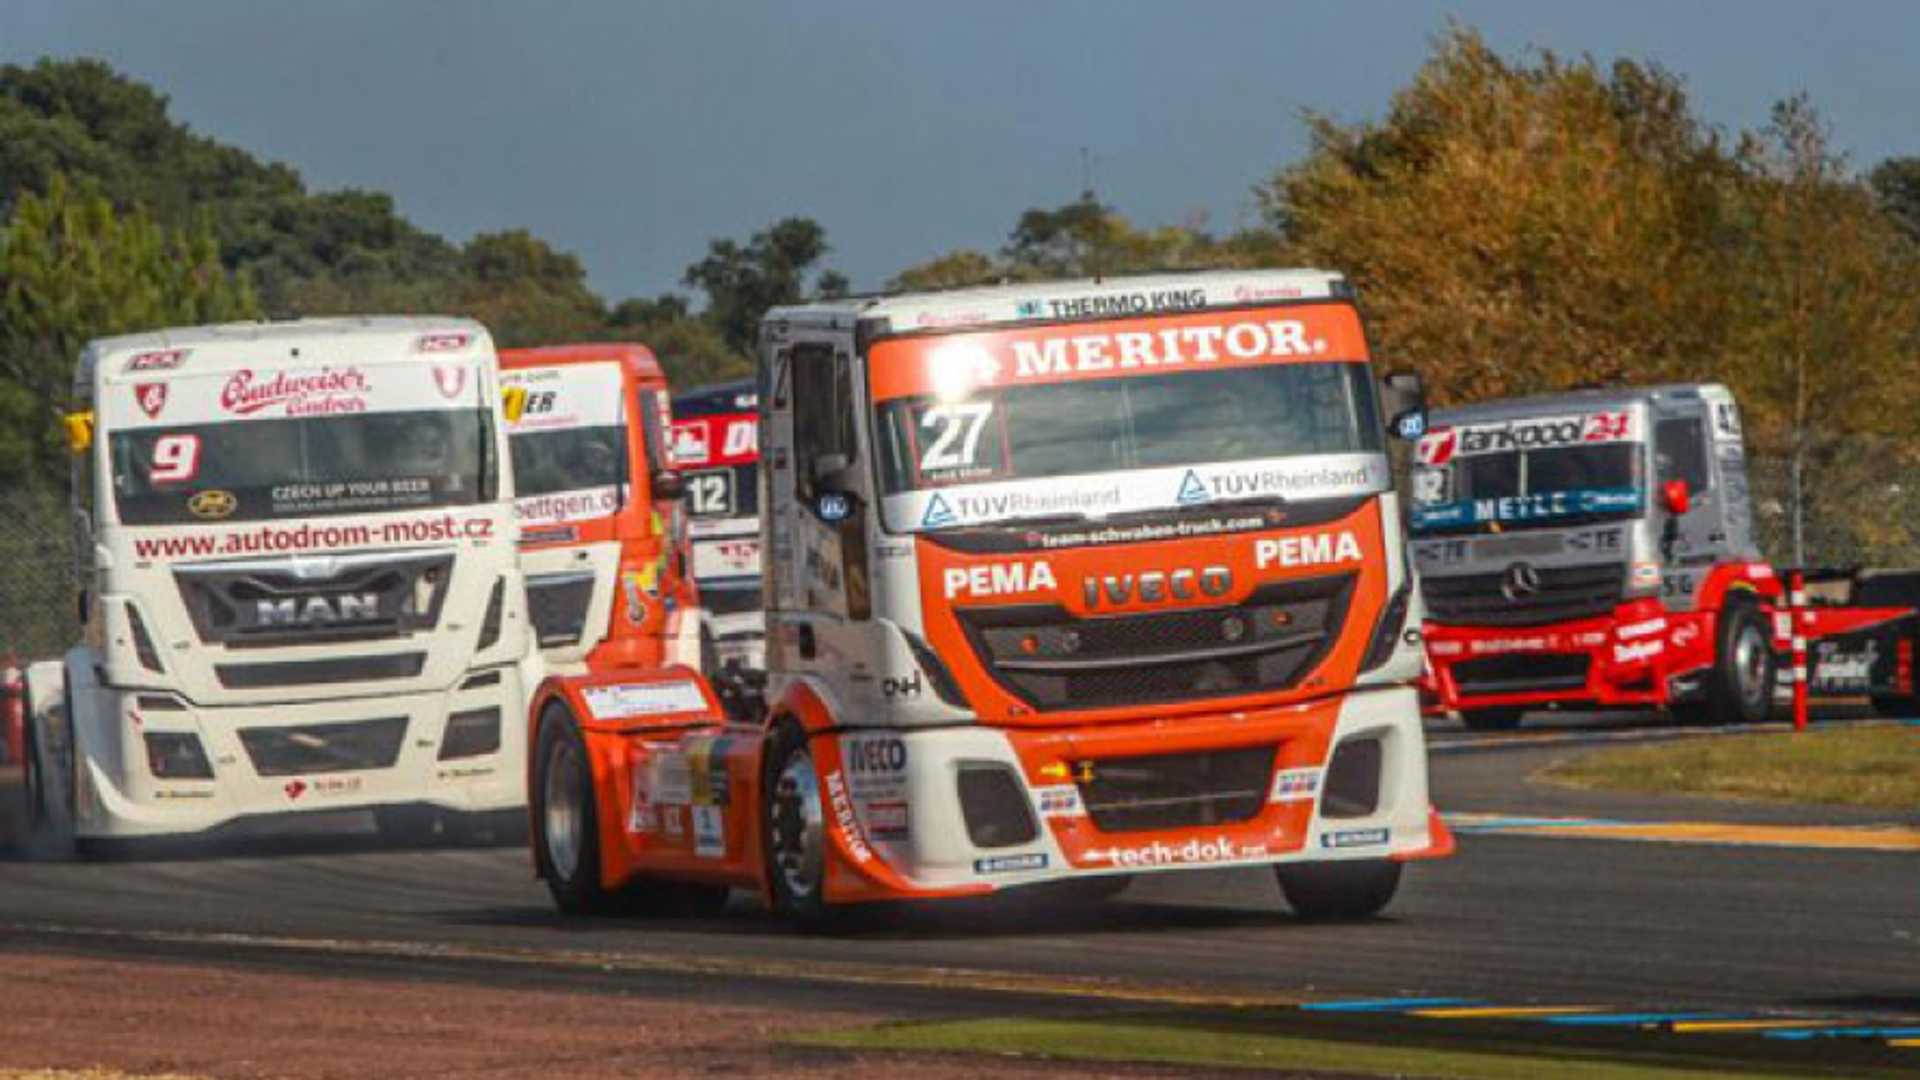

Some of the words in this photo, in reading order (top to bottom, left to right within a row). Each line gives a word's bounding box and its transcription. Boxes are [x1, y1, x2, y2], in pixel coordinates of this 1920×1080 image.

[1051, 297, 1146, 319] THERMO
[1151, 289, 1207, 309] KING
[920, 400, 993, 470] 27
[149, 433, 202, 483] 9
[349, 479, 388, 496] YOUR
[685, 475, 727, 514] 12
[134, 515, 495, 559] www.autodrom-most.cz
[1255, 530, 1363, 570] PEMA
[943, 560, 1057, 599] PEMA
[1083, 565, 1233, 609] IVECO
[256, 592, 381, 627] MAN
[850, 738, 907, 772] IVECO
